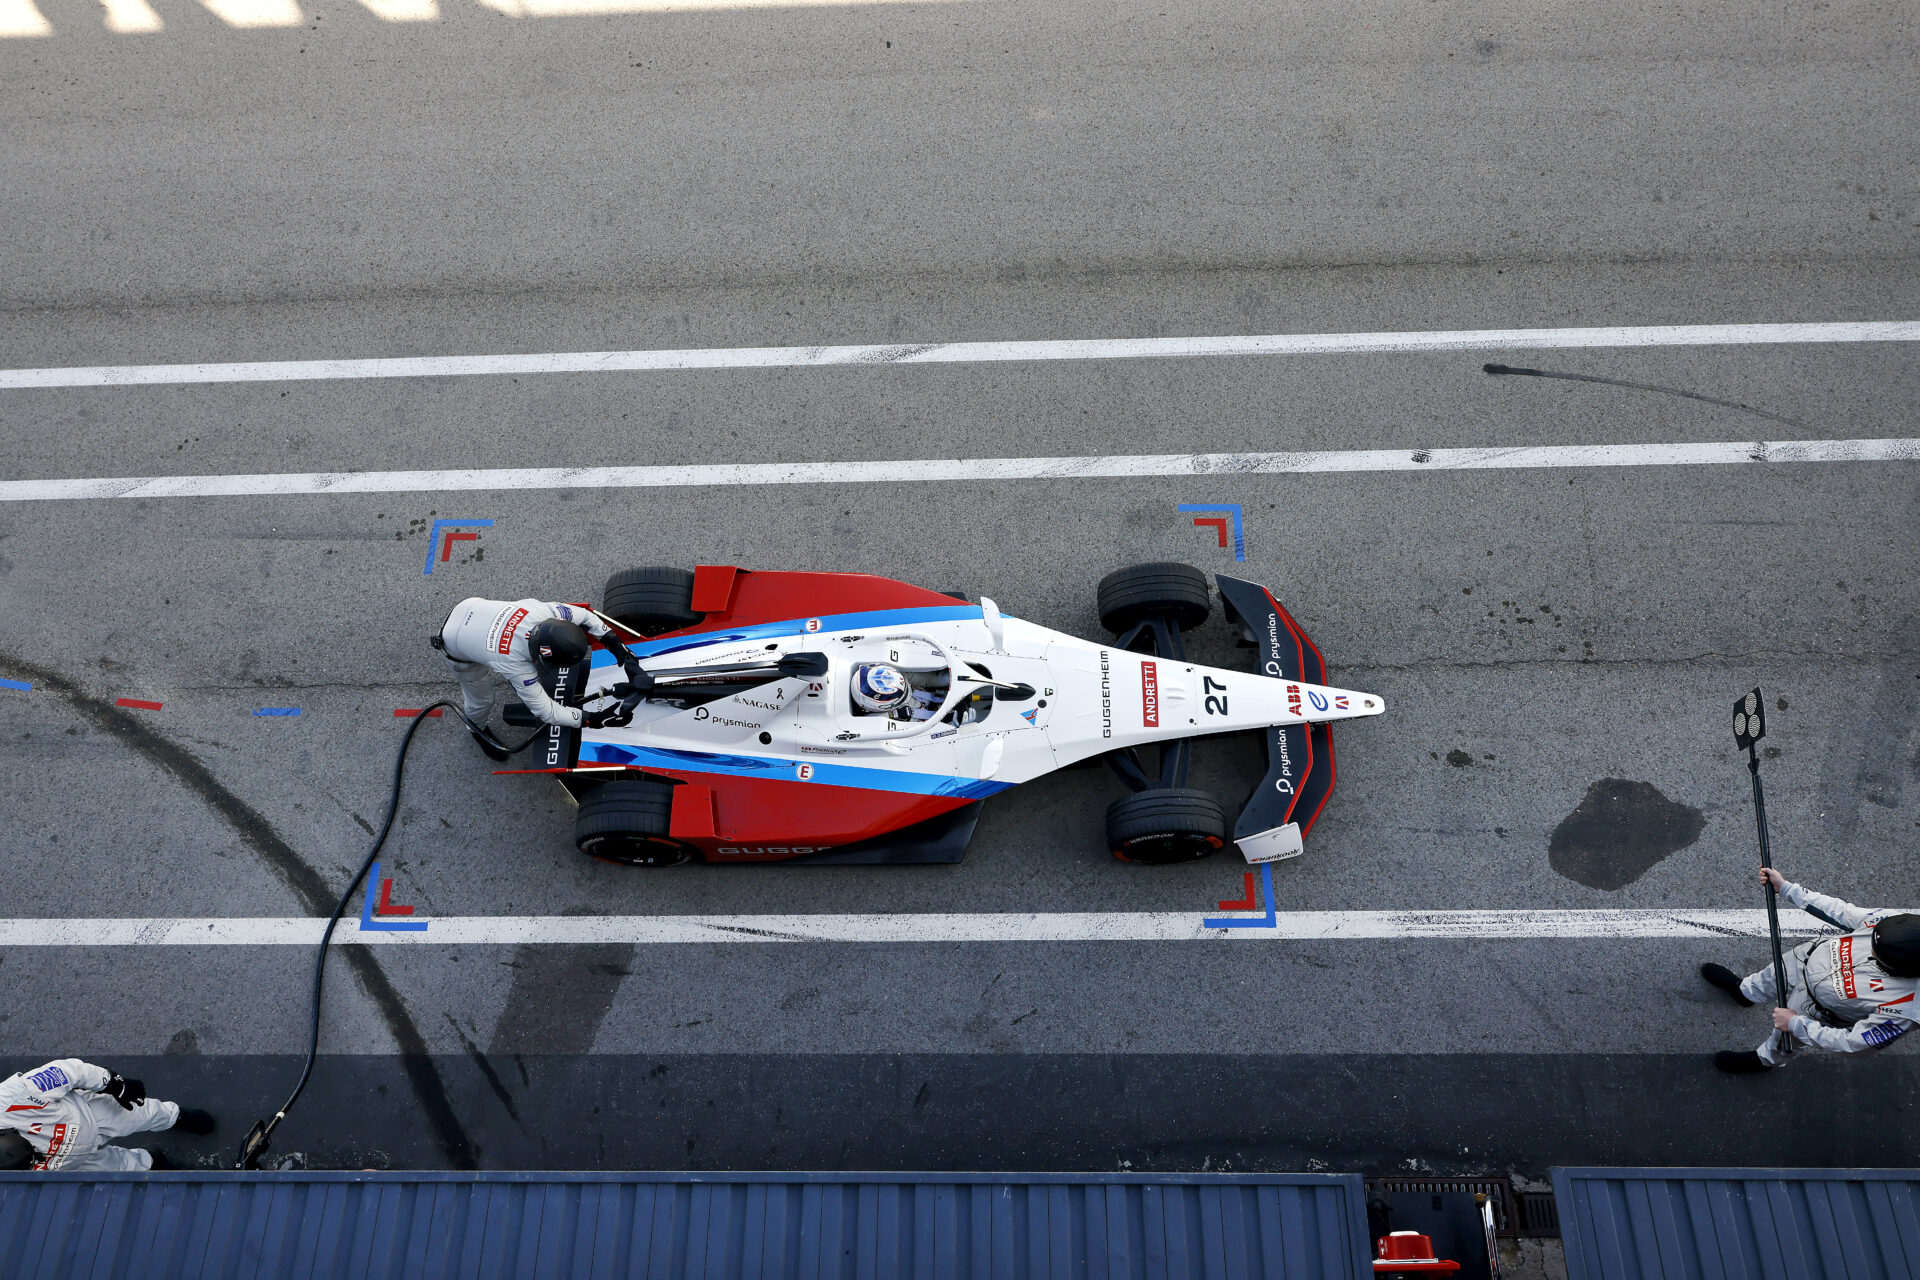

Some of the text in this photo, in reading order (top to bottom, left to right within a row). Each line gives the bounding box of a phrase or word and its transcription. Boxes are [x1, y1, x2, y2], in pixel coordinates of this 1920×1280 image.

[500, 611, 524, 651] ANDRETTI
[1267, 613, 1281, 659] prysmian
[742, 697, 781, 711] NAGASE
[1100, 650, 1111, 738] GUGGENHEIM
[1143, 664, 1156, 722] ANDRETTI
[1203, 675, 1228, 716] 27
[1286, 684, 1302, 716] ABB
[547, 667, 569, 765] GUGNHE
[712, 716, 761, 729] prysmian
[800, 765, 810, 778] E
[1278, 729, 1292, 776] prysmian
[1840, 941, 1855, 995] ANDRETTI
